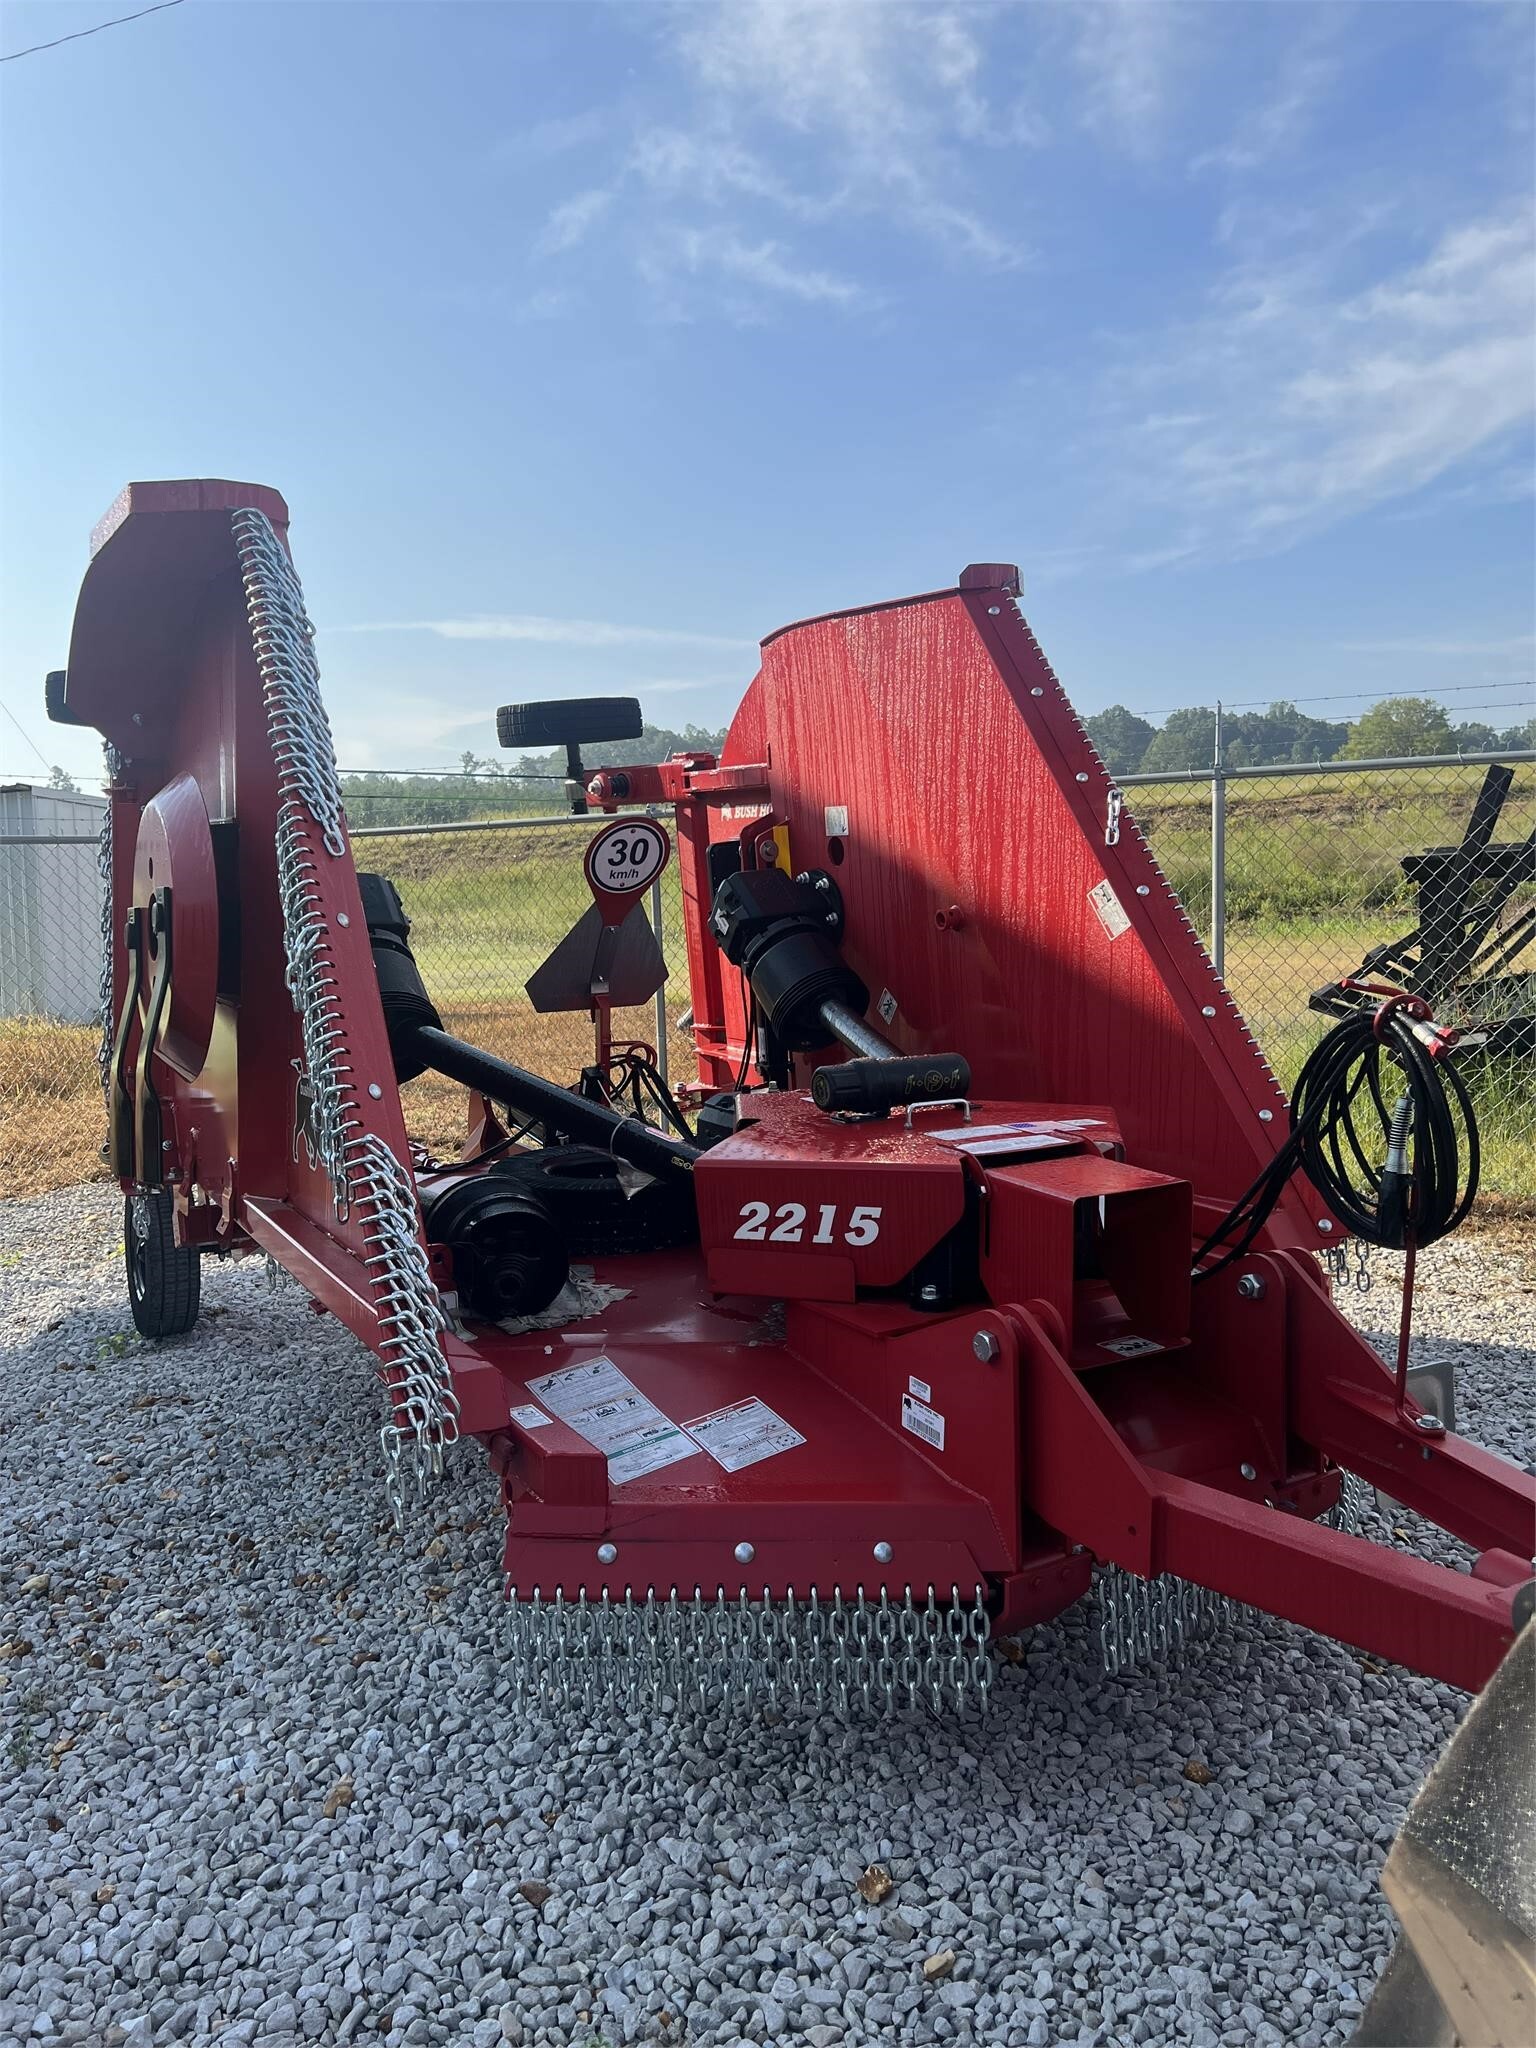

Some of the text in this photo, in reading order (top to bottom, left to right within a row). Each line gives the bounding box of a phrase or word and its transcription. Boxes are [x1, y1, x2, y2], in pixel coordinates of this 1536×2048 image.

[734, 804, 758, 818] BUSH
[607, 838, 649, 866] 30
[609, 868, 639, 880] km/h
[733, 1201, 882, 1246] 2215
[614, 1426, 645, 1439] WARNING
